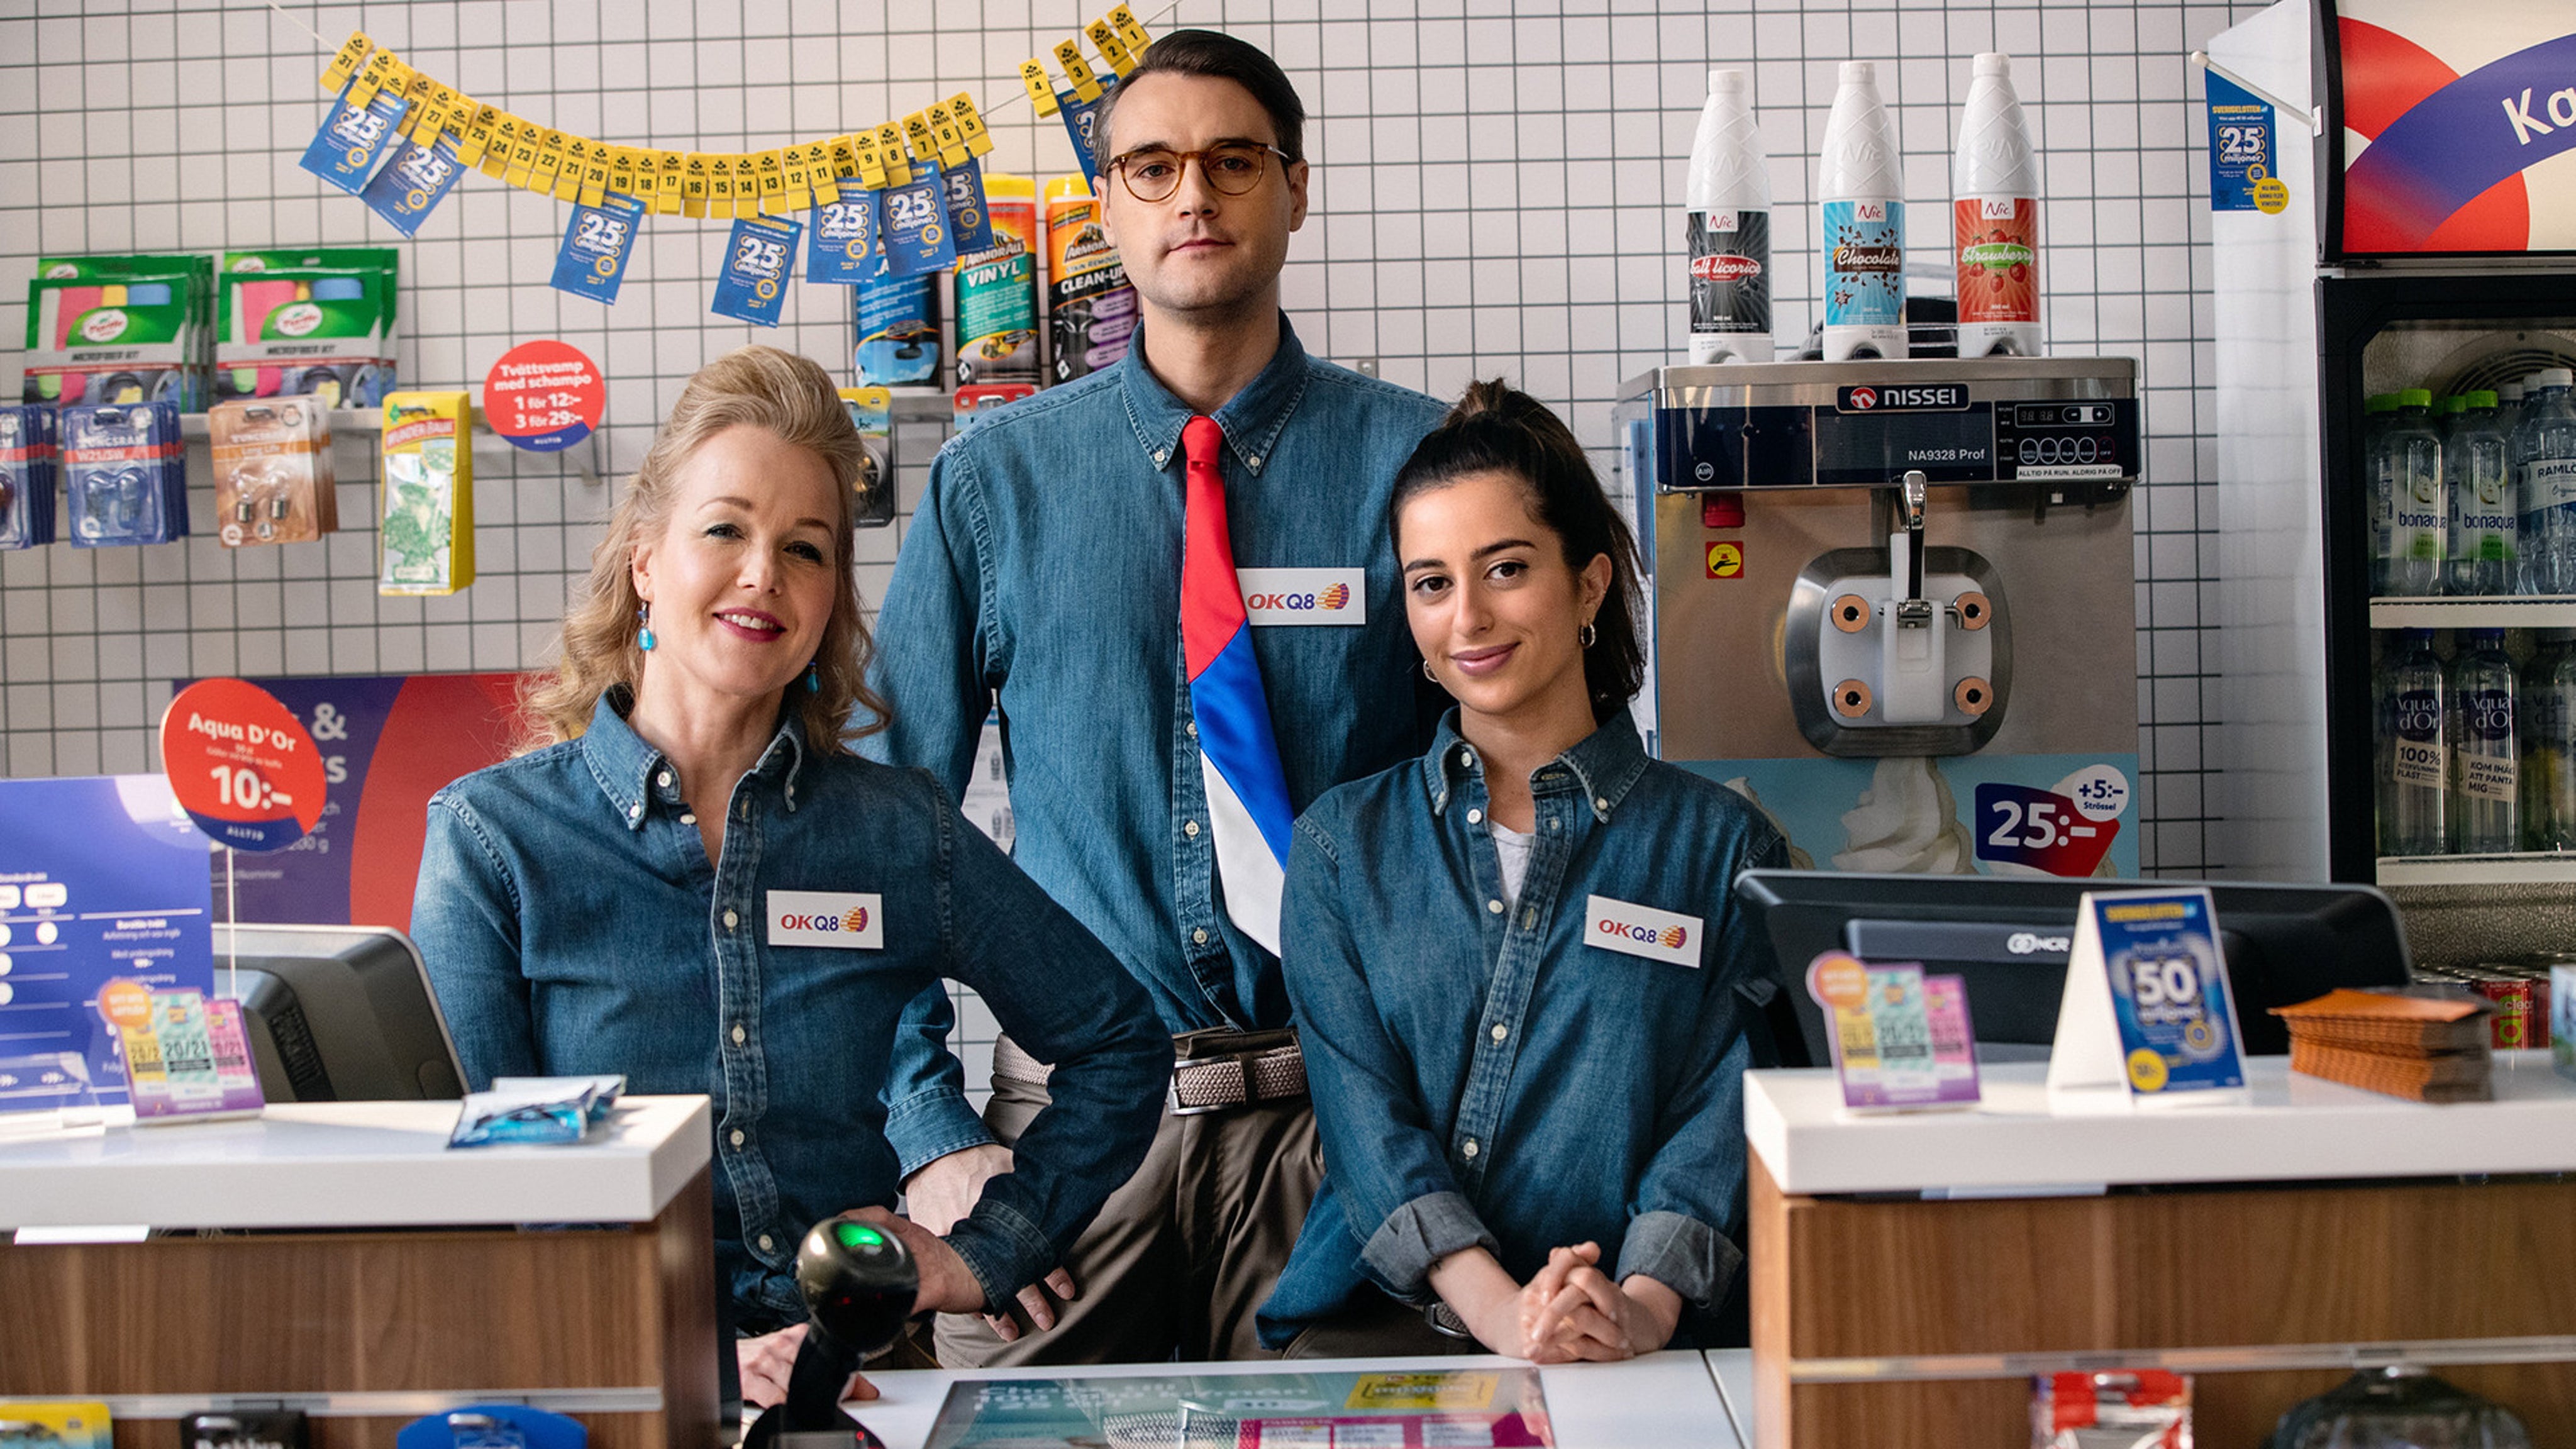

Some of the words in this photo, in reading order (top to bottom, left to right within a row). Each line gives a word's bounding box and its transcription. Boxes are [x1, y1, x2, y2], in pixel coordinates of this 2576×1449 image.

[1130, 30, 1138, 40] 1
[1108, 45, 1118, 57] 2
[338, 55, 353, 69] 31
[364, 71, 379, 86] 30
[1073, 66, 1083, 78] 3
[1035, 81, 1041, 90] 4
[340, 104, 385, 140] 25
[427, 109, 440, 123] 27
[2502, 87, 2576, 145] Ka
[965, 119, 975, 131] 5
[472, 127, 486, 140] 25
[942, 129, 952, 140] 6
[2223, 127, 2261, 154] 25
[493, 140, 508, 154] 24
[919, 142, 927, 152] 7
[516, 148, 531, 161] 23
[541, 154, 557, 167] 22
[865, 154, 873, 164] 9
[890, 150, 897, 161] 8
[2224, 153, 2261, 164] miljoner
[408, 145, 449, 183] 25
[566, 162, 579, 175] 21
[589, 169, 603, 182] 20
[791, 172, 802, 184] 12
[817, 167, 827, 178] 11
[841, 166, 853, 177] 10
[615, 177, 627, 187] 19
[640, 179, 652, 190] 18
[666, 176, 676, 186] 17
[690, 182, 701, 193] 16
[716, 182, 728, 193] 15
[740, 181, 752, 192] 14
[765, 177, 777, 189] 13
[891, 191, 931, 220] 25
[1858, 204, 1881, 219] Nic
[1985, 202, 2010, 216] Nic
[823, 203, 863, 230] 25
[1709, 214, 1731, 228] Nic
[581, 214, 623, 247] 25
[740, 238, 780, 269] 25
[1838, 248, 1899, 265] Chocolate
[1962, 245, 2035, 267] Strawberry
[1713, 257, 1762, 274] licorice
[967, 261, 1020, 287] VINYL
[499, 361, 584, 377] Tvättsvamp
[494, 377, 526, 391] med
[528, 374, 592, 389] schampo
[514, 396, 525, 410] 1
[1884, 387, 1957, 406] NISSEI
[514, 414, 527, 428] 3
[1908, 449, 1955, 461] NA9328
[1960, 448, 1985, 460] Prof
[2043, 468, 2053, 476] PÅ
[2099, 467, 2107, 475] PÅ
[2399, 511, 2447, 531] bonaqua
[2463, 513, 2515, 532] bonaqua
[188, 712, 244, 740] Aqua
[248, 724, 296, 752] D'Or
[2399, 746, 2441, 765] 100%
[2470, 761, 2492, 772] KOM
[2397, 769, 2421, 780] PLAST
[2469, 772, 2485, 783] ATT
[210, 765, 292, 810] 10:-
[2078, 779, 2124, 799] +5:-
[2468, 782, 2487, 794] MIG
[2083, 801, 2116, 811] Strössel
[1989, 800, 2097, 849] 25:-
[2135, 960, 2197, 1005] 50
[165, 1040, 208, 1057] 20/21
